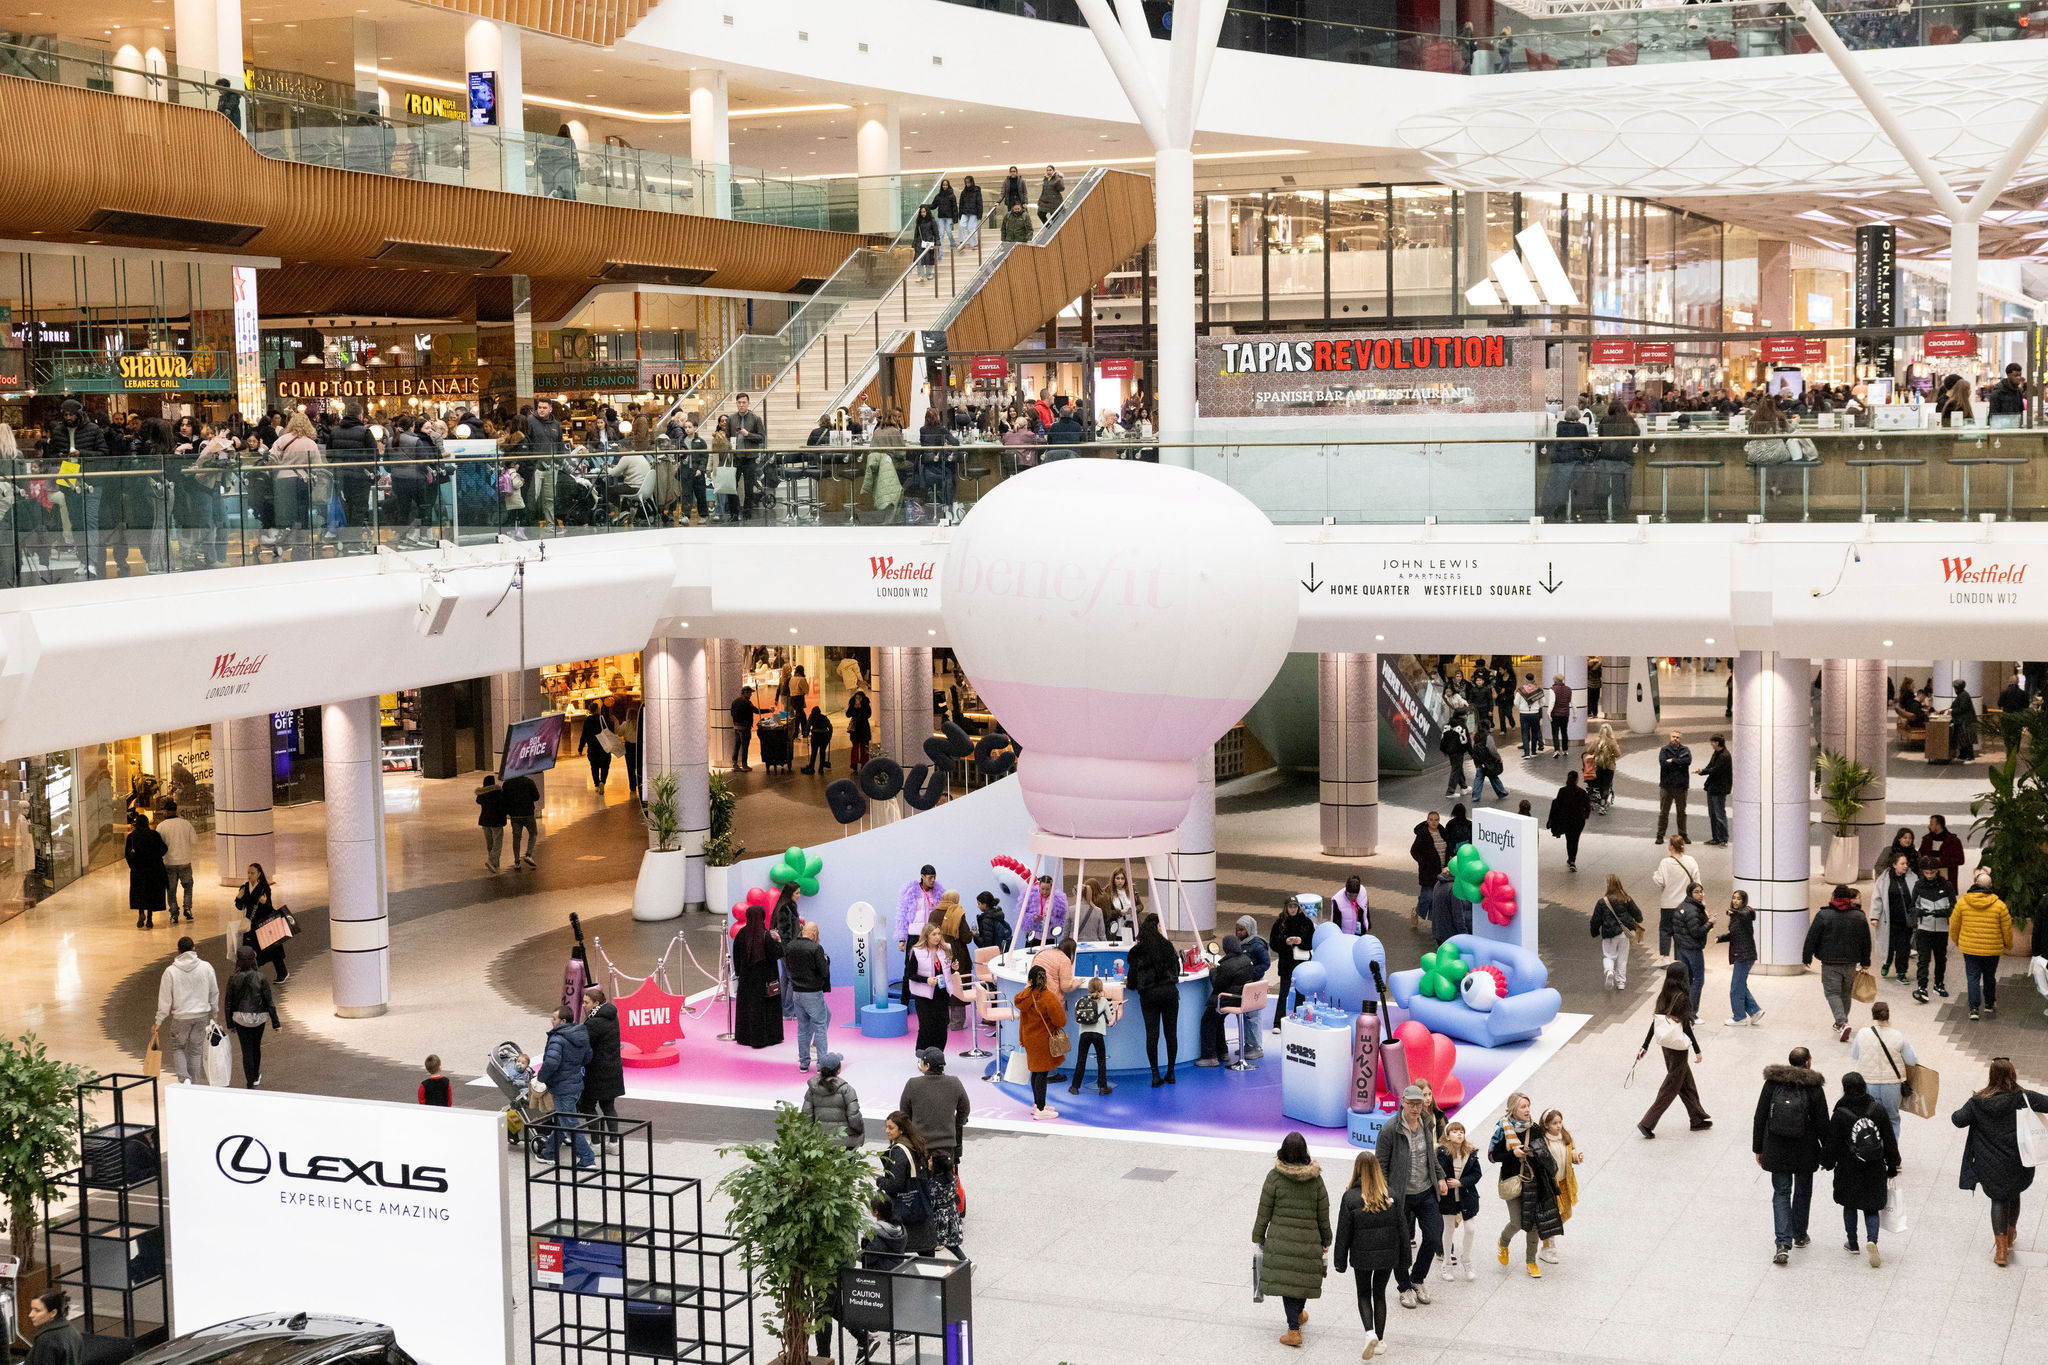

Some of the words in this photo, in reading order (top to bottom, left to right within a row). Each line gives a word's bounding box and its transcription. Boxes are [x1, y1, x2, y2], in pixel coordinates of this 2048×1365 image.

[1221, 342, 1313, 373] TAPAS
[1313, 335, 1504, 371] REVOLUTION
[124, 380, 159, 388] LEBANESE
[160, 380, 180, 388] GRILL
[279, 380, 377, 398] COMPTOIR
[381, 378, 480, 396] LIBANAIS
[562, 376, 577, 387] OF
[581, 375, 636, 387] LEBANON
[1256, 391, 1313, 403] SPANISH
[1316, 391, 1344, 402] BAR
[1379, 387, 1470, 400] RESTAURANT
[869, 556, 936, 581] Westfield
[1383, 560, 1423, 570] JOHN
[1430, 560, 1478, 569] LEWIS
[1939, 556, 2028, 584] Westfield
[956, 535, 1174, 617] benefit
[877, 587, 910, 598] LONDON
[913, 587, 929, 598] W12
[1330, 585, 1358, 595] HOME
[1362, 585, 1410, 596] QUARTER
[1424, 585, 1482, 596] WESTFIELD
[1490, 585, 1532, 596] SQUARE
[1950, 593, 1993, 604] LONDON
[1998, 593, 2017, 604] W12
[209, 652, 268, 680] Westfield
[205, 685, 235, 699] LONDON
[275, 717, 293, 729] OFF
[529, 736, 542, 746] BOX
[178, 750, 210, 766] Science
[520, 743, 547, 759] OFFICE
[826, 721, 1017, 824] BOUNC
[1478, 823, 1515, 851] benefit
[856, 937, 867, 974] BOUNCE
[629, 1007, 670, 1026] NEW!
[1356, 1035, 1373, 1098] BOUNCE
[279, 1152, 448, 1193] LEXUS
[281, 1191, 373, 1213] EXPERIENCE
[379, 1202, 450, 1221] AMAZING
[850, 1298, 863, 1306] Mind
[851, 1290, 880, 1299] CAUTION
